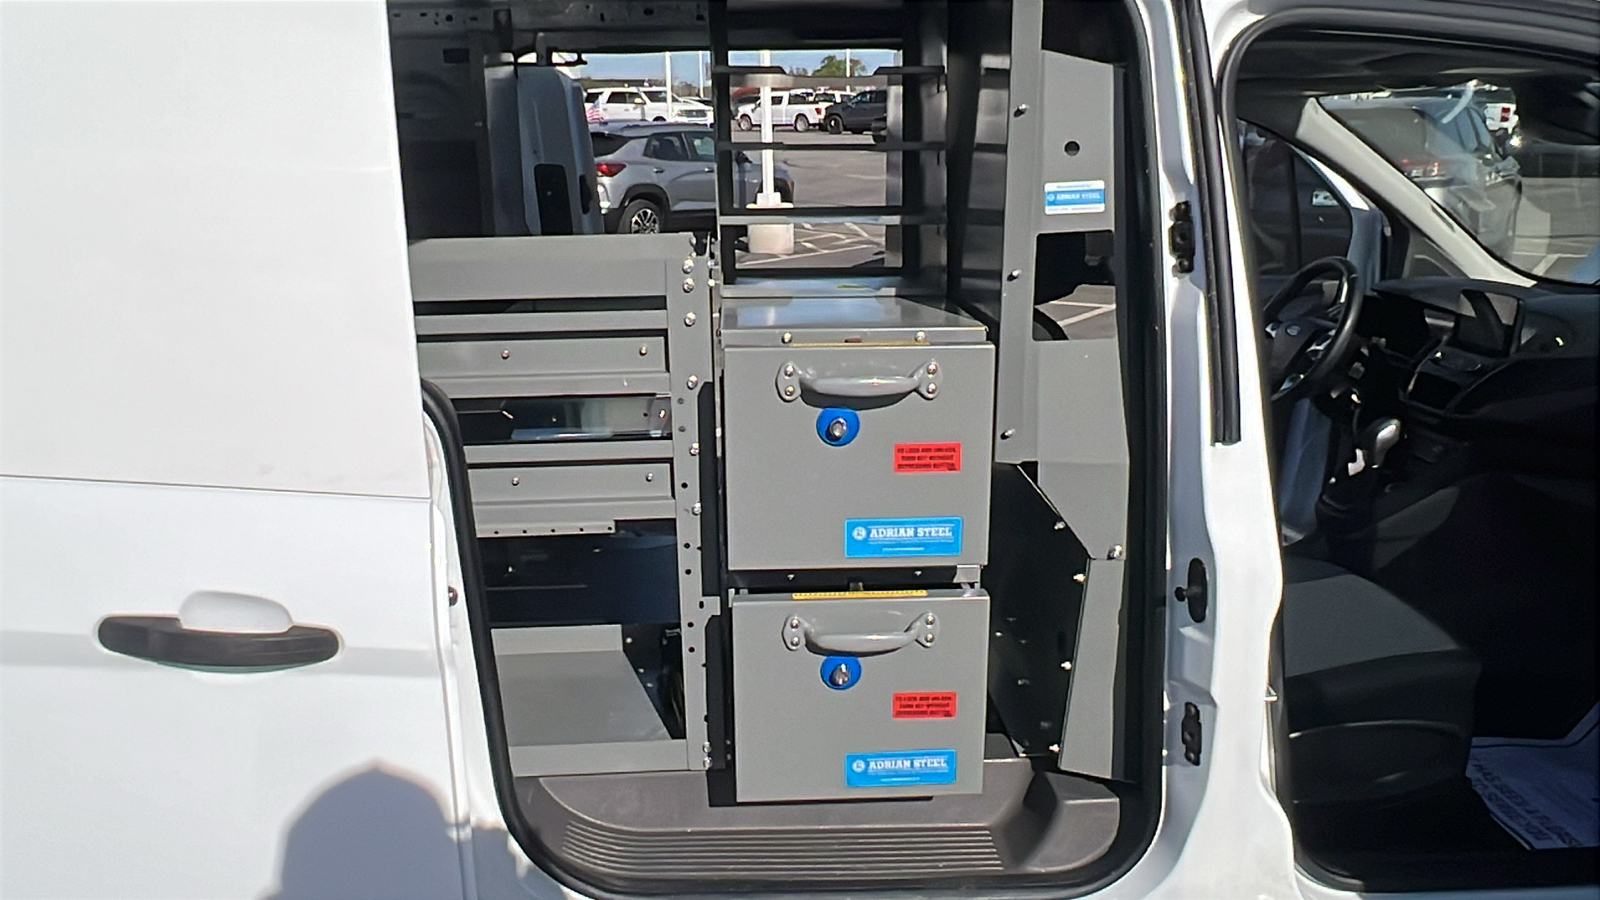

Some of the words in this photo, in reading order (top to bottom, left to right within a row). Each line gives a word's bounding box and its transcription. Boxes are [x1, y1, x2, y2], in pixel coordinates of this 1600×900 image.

[870, 526, 914, 538] ADRIAN
[917, 526, 952, 538] STEEL
[869, 760, 911, 770] ADRIAN
[913, 758, 947, 768] STEEL
